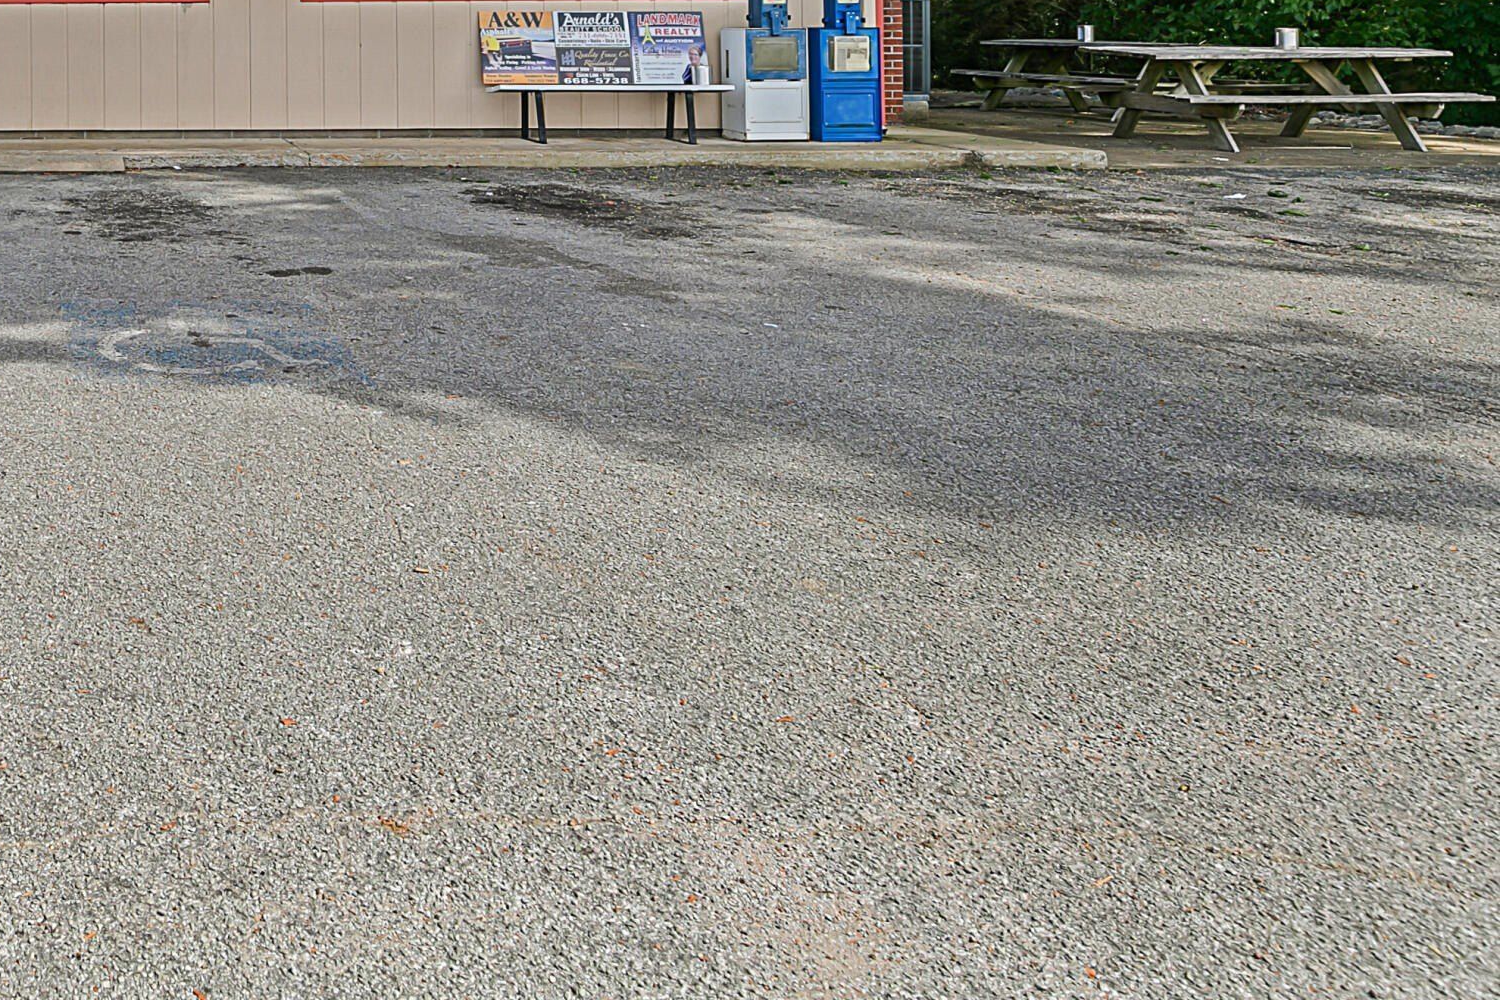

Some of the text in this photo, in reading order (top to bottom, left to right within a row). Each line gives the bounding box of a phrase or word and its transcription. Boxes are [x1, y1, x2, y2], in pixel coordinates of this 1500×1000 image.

[488, 12, 544, 28] A&W
[562, 12, 620, 27] Arnold's
[636, 13, 701, 27] LANDMARK
